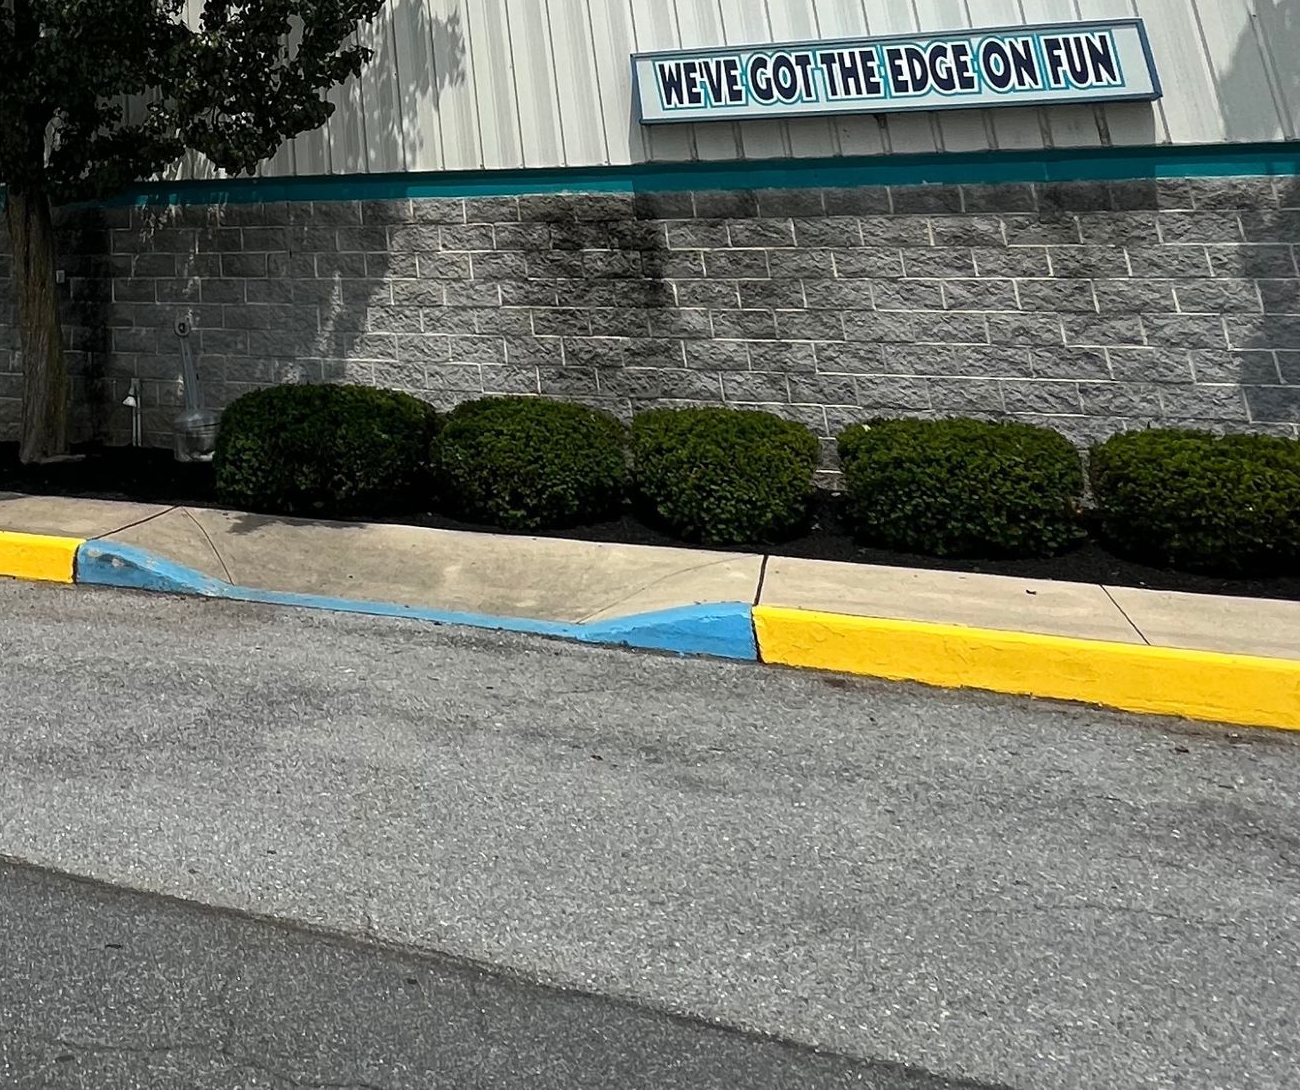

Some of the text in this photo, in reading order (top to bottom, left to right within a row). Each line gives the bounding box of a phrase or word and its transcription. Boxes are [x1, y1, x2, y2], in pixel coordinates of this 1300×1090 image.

[657, 29, 1119, 108] WE'VE GOT THE EDGE ON FUN
